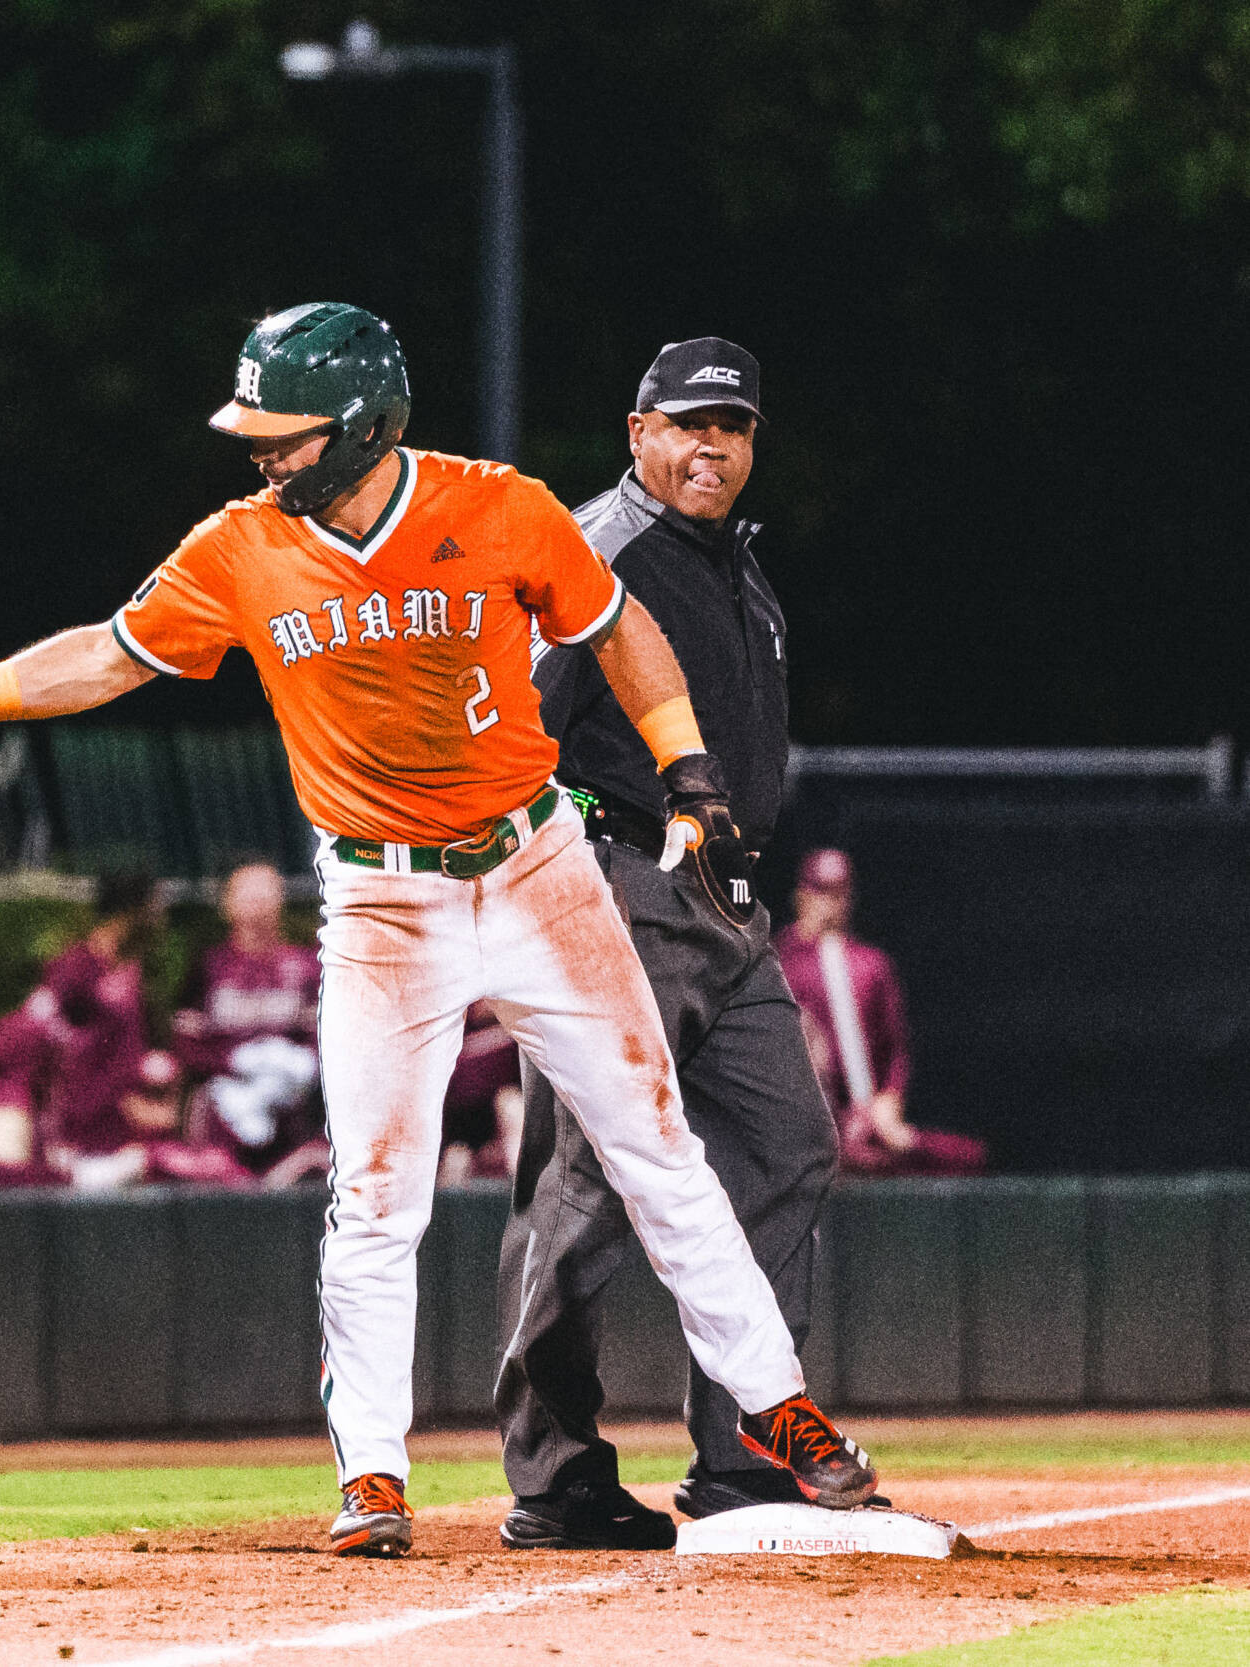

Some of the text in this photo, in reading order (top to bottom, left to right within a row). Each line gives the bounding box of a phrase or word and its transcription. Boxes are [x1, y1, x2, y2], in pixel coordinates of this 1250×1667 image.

[690, 366, 741, 382] ACC
[430, 549, 466, 564] adidas
[269, 586, 488, 668] MIAMI
[455, 664, 501, 738] 2
[782, 1539, 858, 1553] BASEBALL
